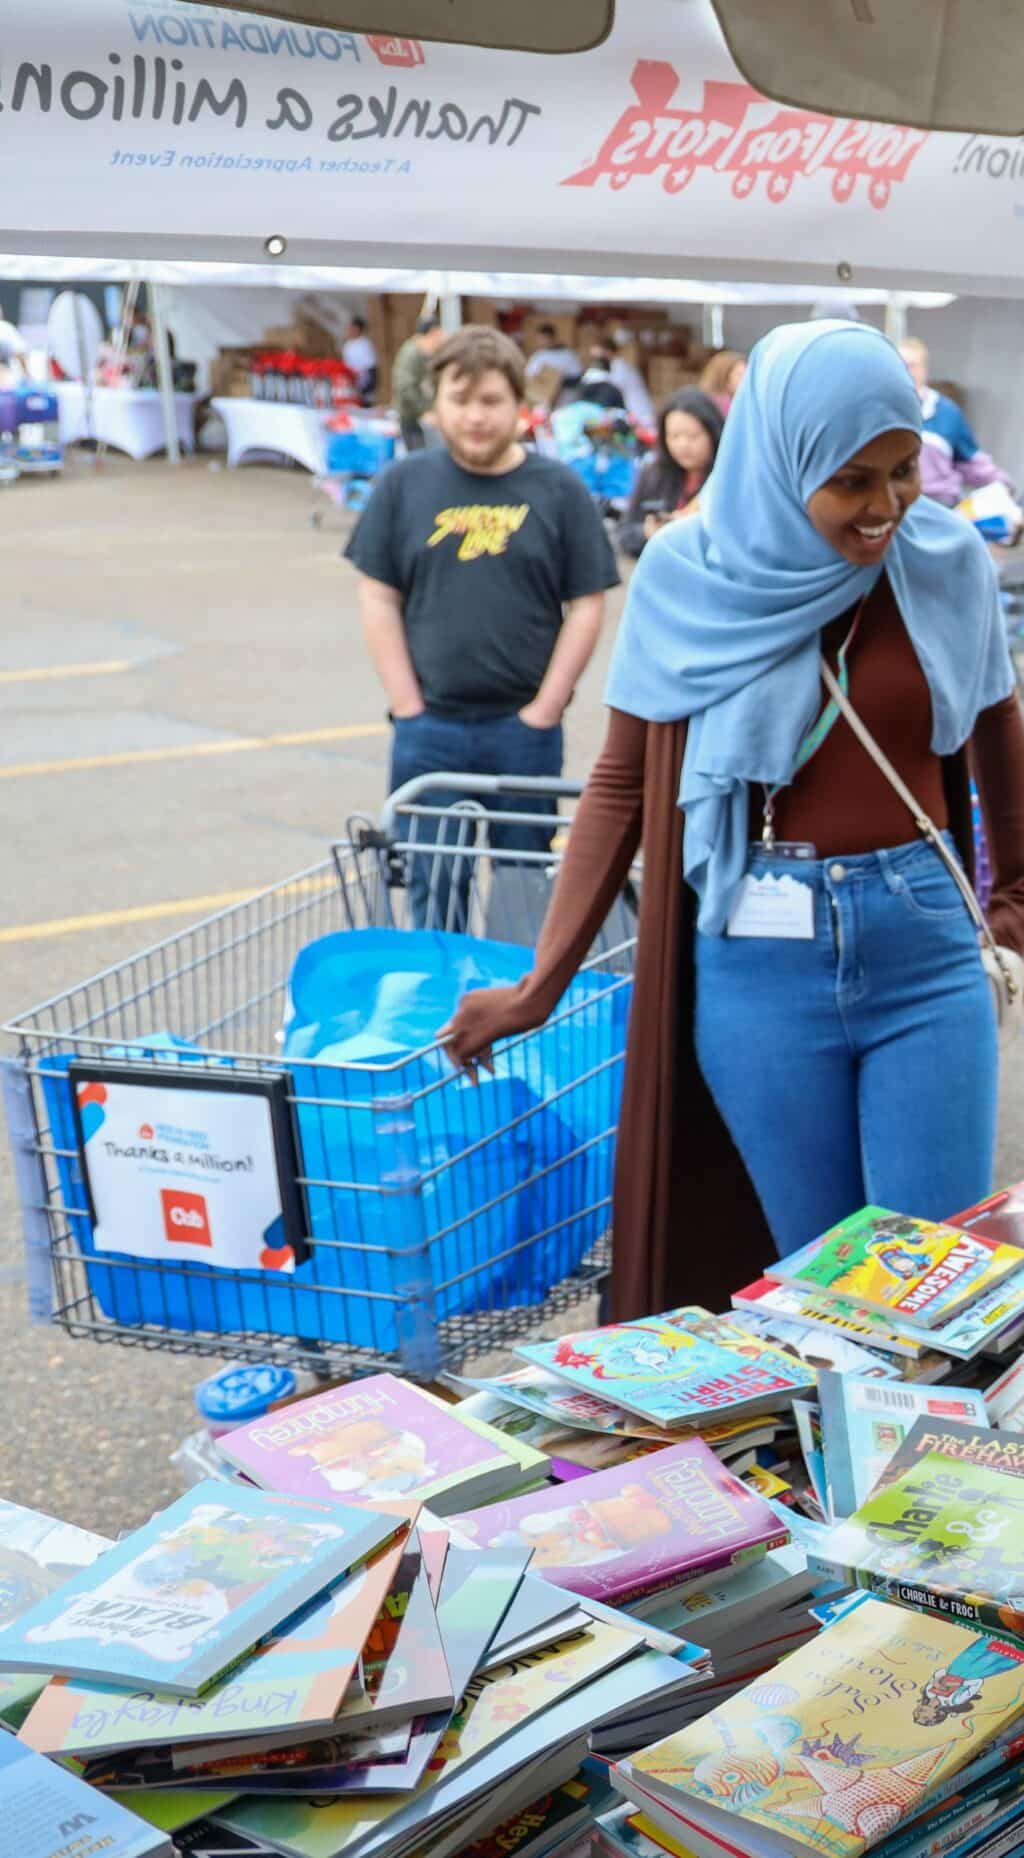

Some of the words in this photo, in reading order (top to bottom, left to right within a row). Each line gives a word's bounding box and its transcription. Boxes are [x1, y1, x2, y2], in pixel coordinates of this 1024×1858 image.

[103, 1140, 169, 1164] Thanks
[189, 1155, 254, 1174] Million!
[898, 1234, 996, 1312] AWESOME
[670, 1365, 769, 1405] START!
[694, 1375, 796, 1409] PRESS
[249, 1389, 400, 1452] Humphrey
[655, 1457, 749, 1541] Humphrey
[866, 1473, 964, 1549] Charlie
[945, 1508, 999, 1540] &
[900, 1586, 937, 1609] CHARLIE
[950, 1601, 974, 1619] FROG
[819, 1649, 918, 1700] Stories
[70, 1691, 187, 1741] Kayla
[212, 1685, 298, 1720] King
[495, 1812, 546, 1854] Hey
